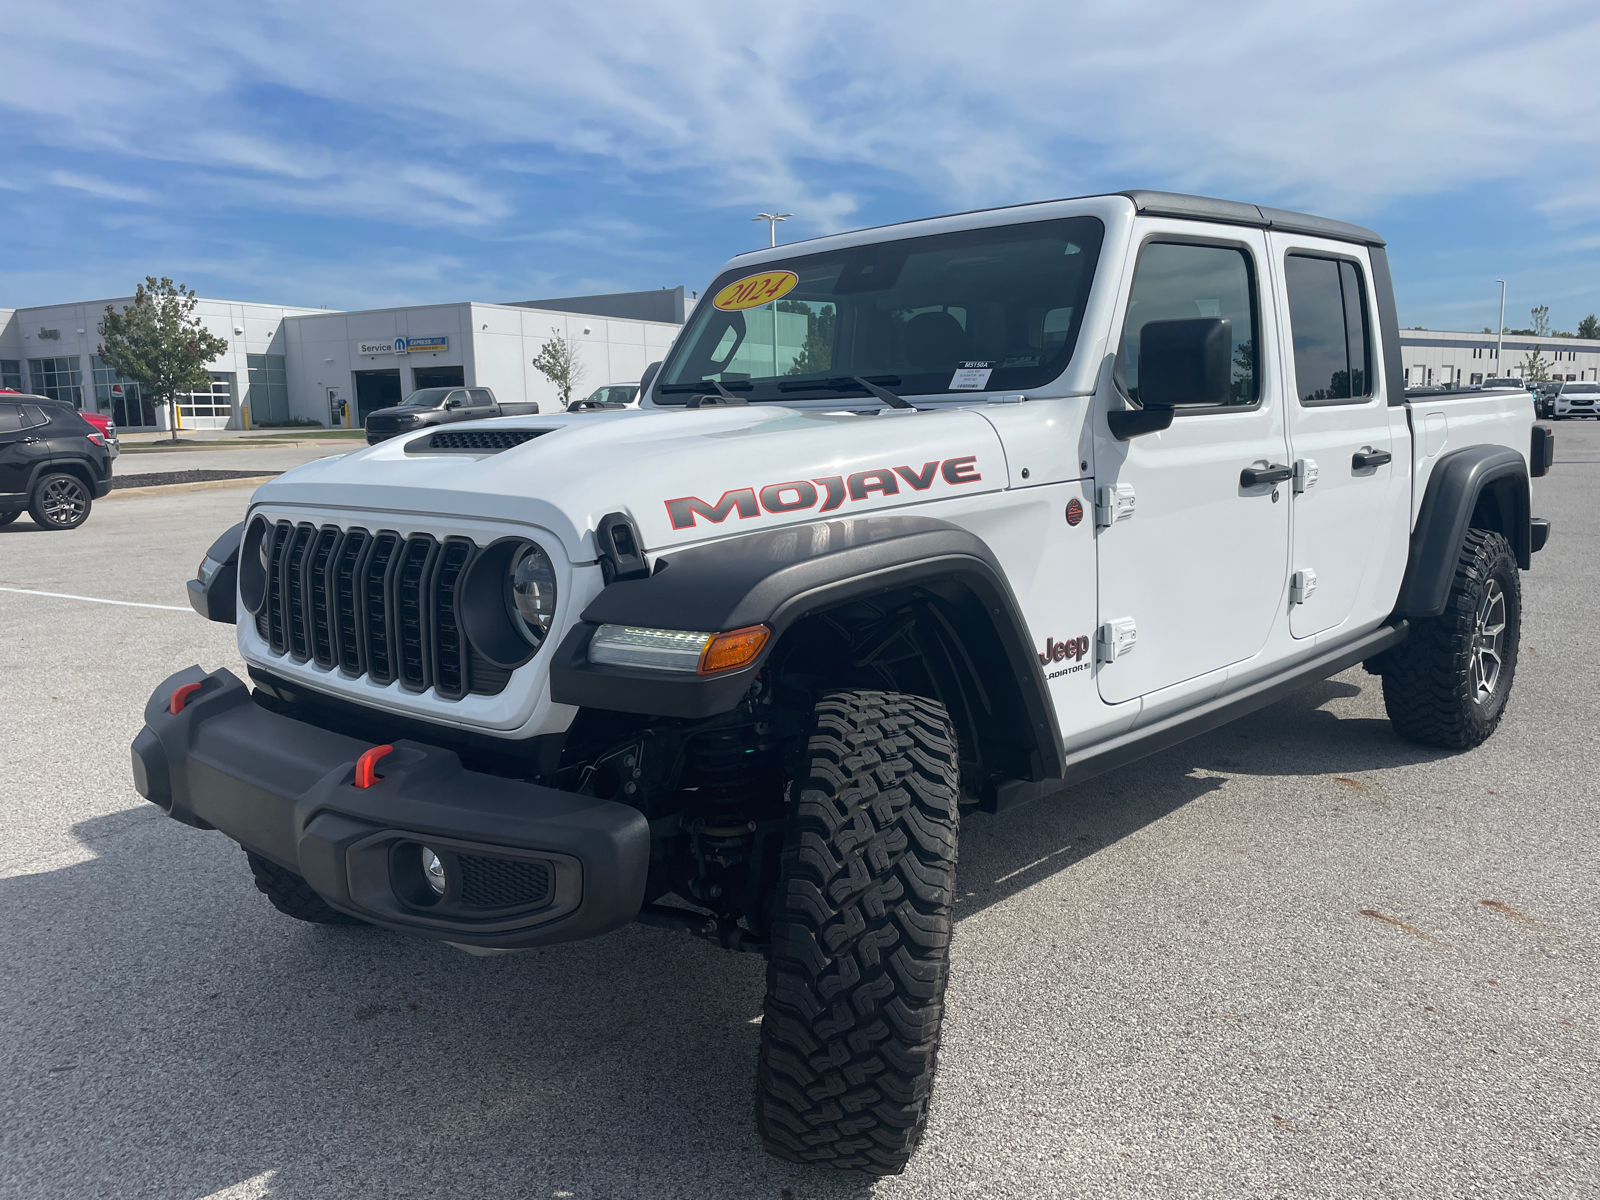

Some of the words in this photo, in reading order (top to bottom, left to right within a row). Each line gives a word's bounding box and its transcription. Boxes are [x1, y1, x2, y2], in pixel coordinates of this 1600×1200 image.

[721, 274, 789, 306] 2024
[361, 343, 392, 353] Service
[664, 455, 982, 530] MOJAVE
[1038, 635, 1089, 666] Jeep
[1044, 664, 1083, 680] LADIATOR
